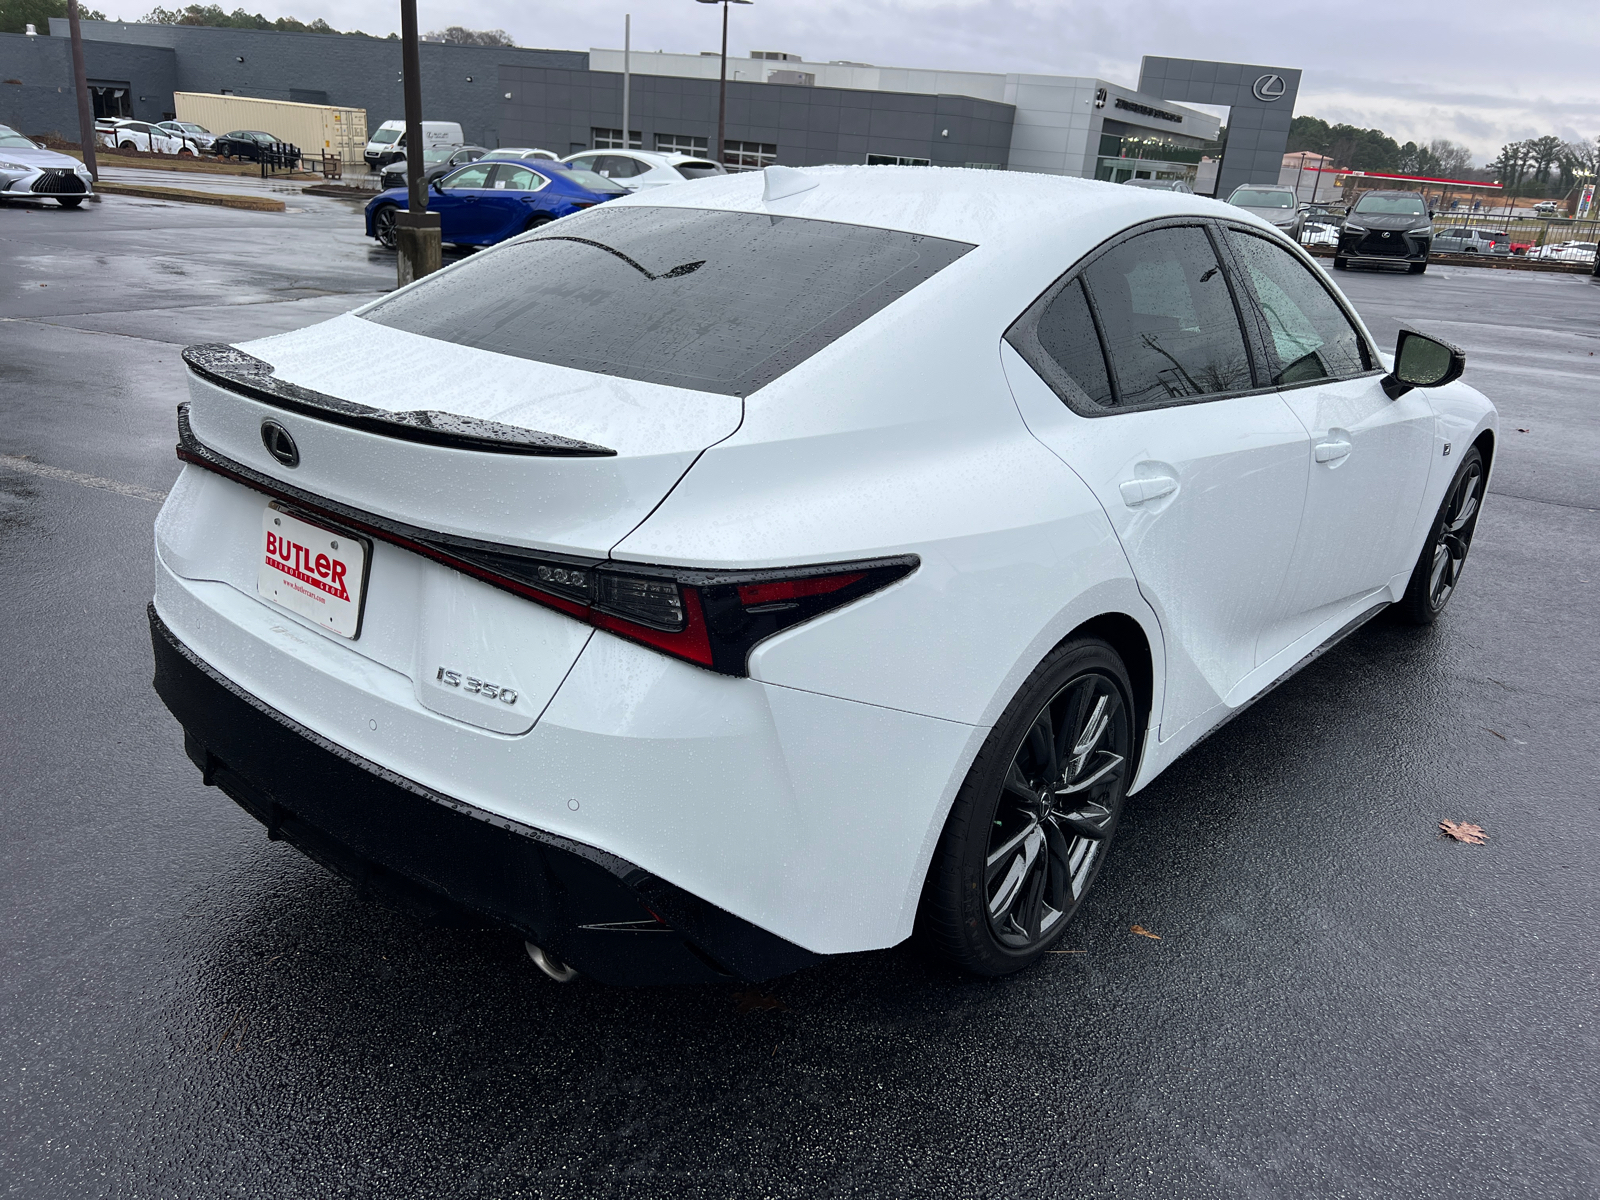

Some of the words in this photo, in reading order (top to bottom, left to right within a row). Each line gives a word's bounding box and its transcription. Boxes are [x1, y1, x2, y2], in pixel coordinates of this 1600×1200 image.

[266, 555, 313, 584] AUTOMOTIVE
[320, 582, 347, 600] GROUP
[283, 579, 326, 605] www.butlercars.com
[436, 666, 462, 688] IS
[464, 676, 519, 706] 350
